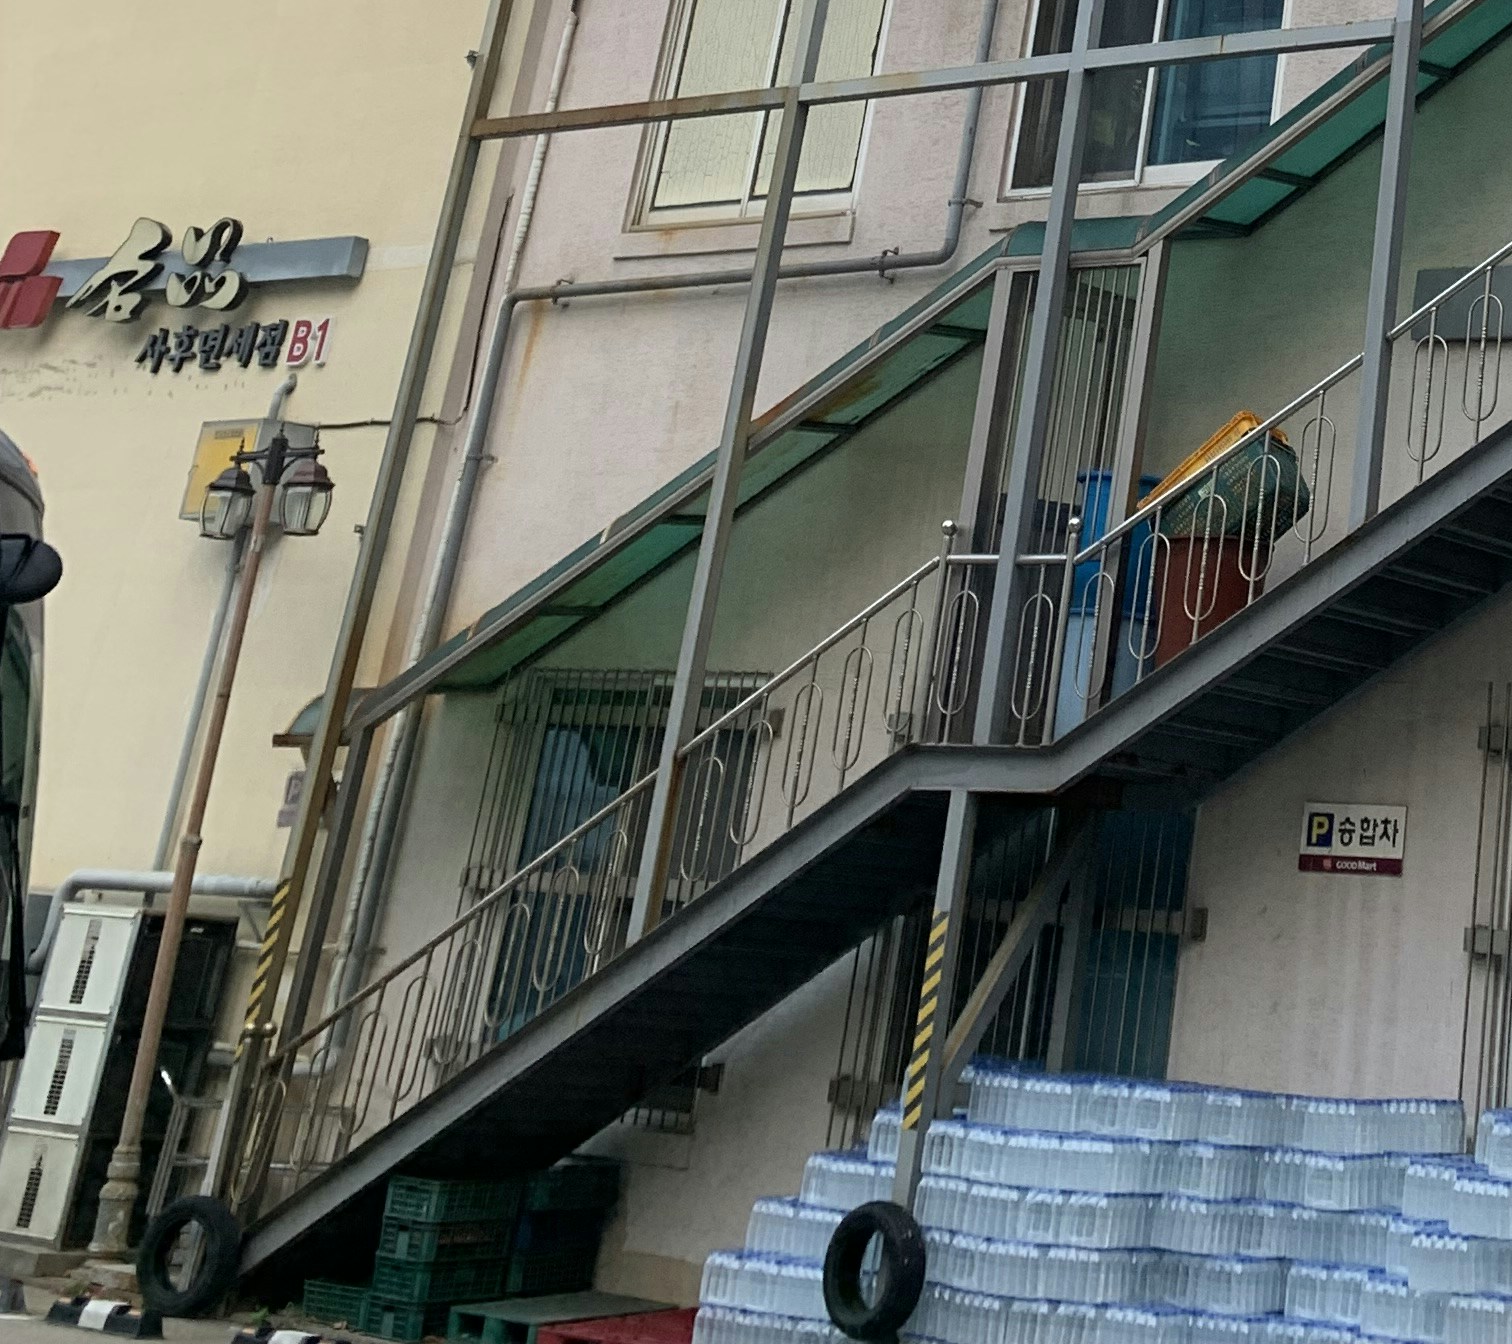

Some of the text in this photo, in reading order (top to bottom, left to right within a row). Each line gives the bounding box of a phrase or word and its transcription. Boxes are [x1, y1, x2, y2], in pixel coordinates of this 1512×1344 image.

[134, 318, 331, 374] 사후면세점 B1
[1310, 815, 1330, 845] P
